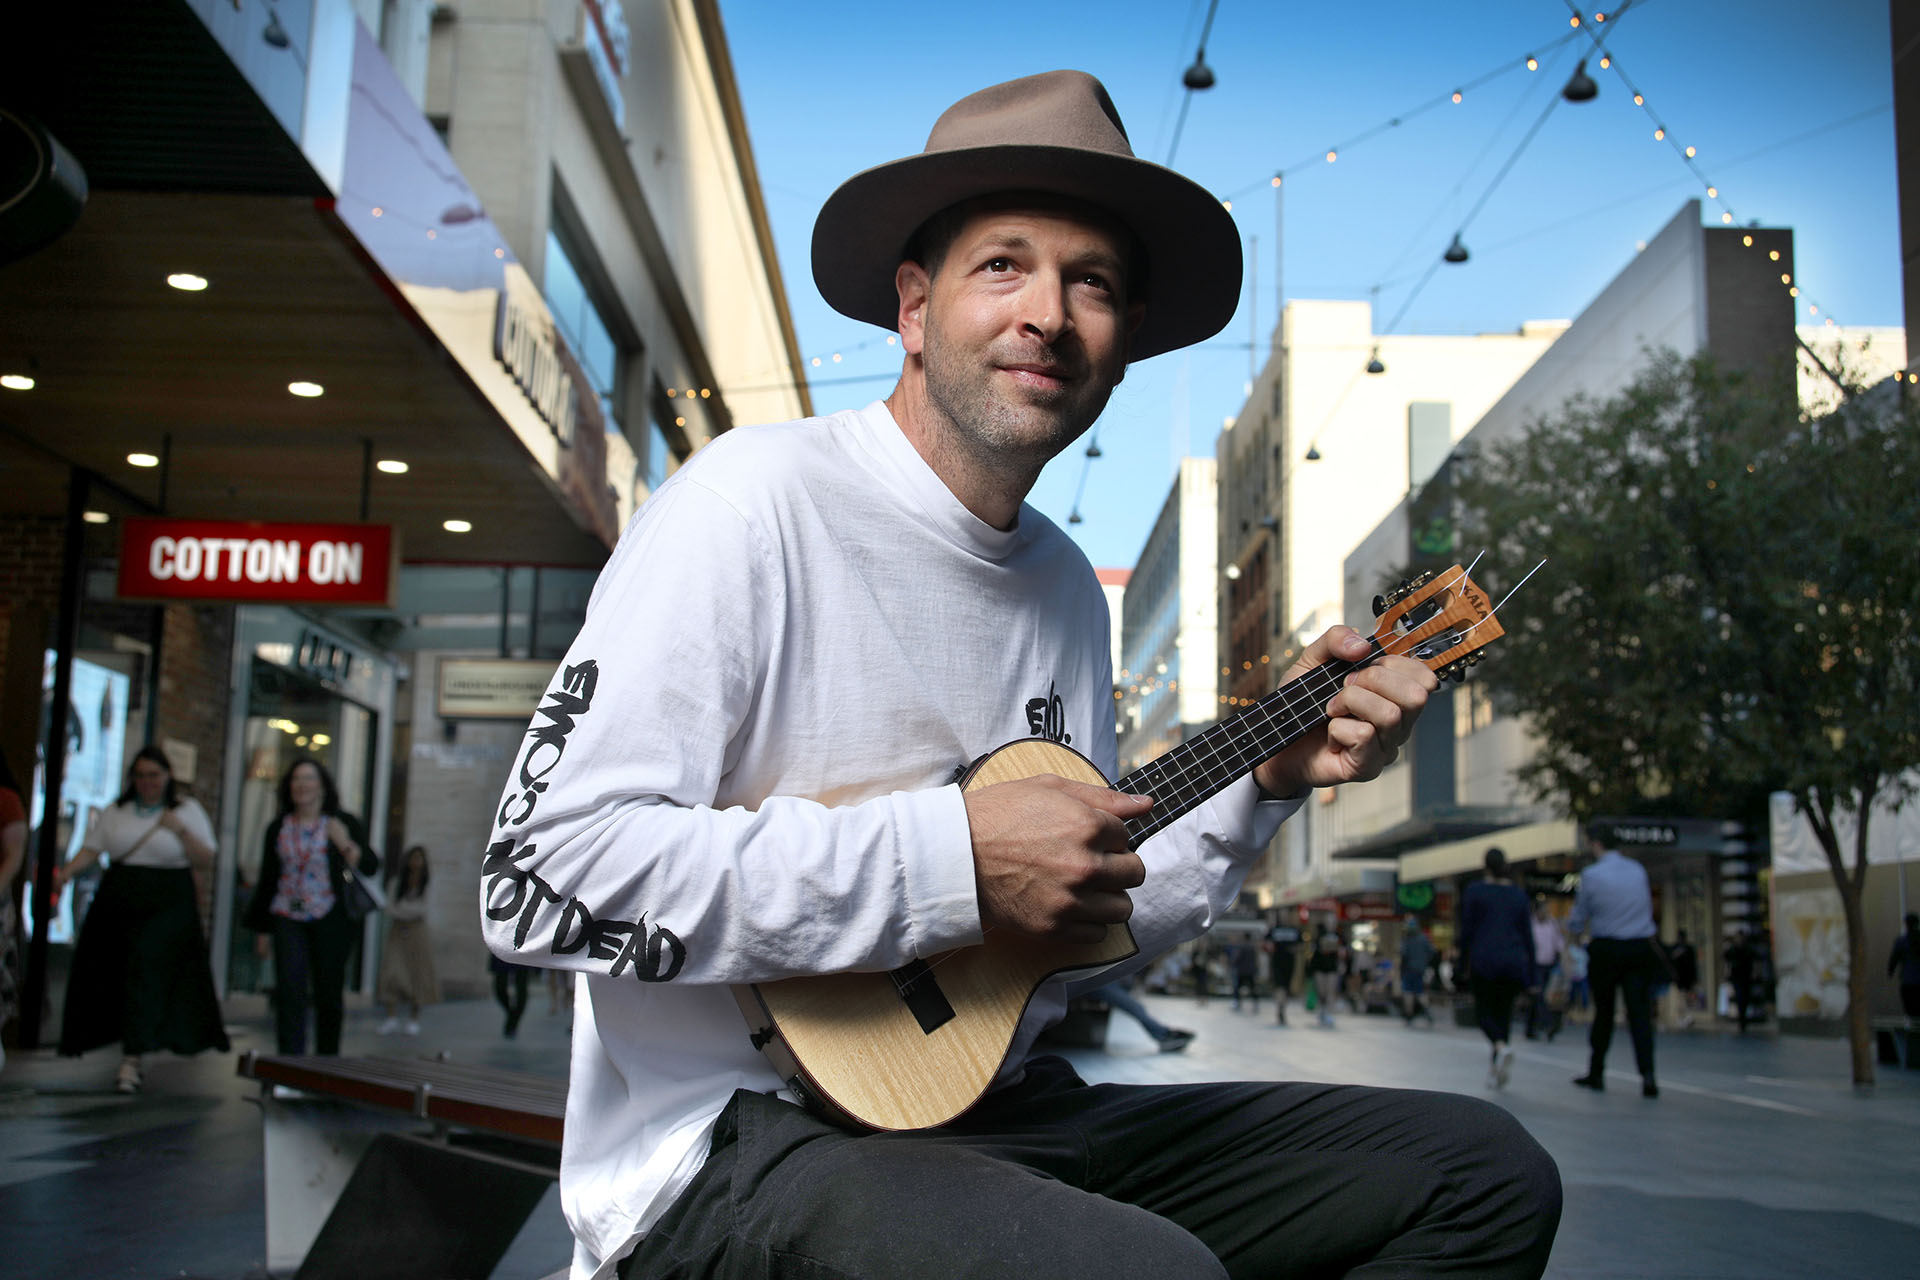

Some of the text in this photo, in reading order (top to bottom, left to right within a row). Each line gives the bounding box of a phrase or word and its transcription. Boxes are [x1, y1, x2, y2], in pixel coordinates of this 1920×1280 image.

[150, 536, 363, 585] COTTON ON
[483, 839, 563, 950] NOT
[552, 894, 687, 982] DEAD
